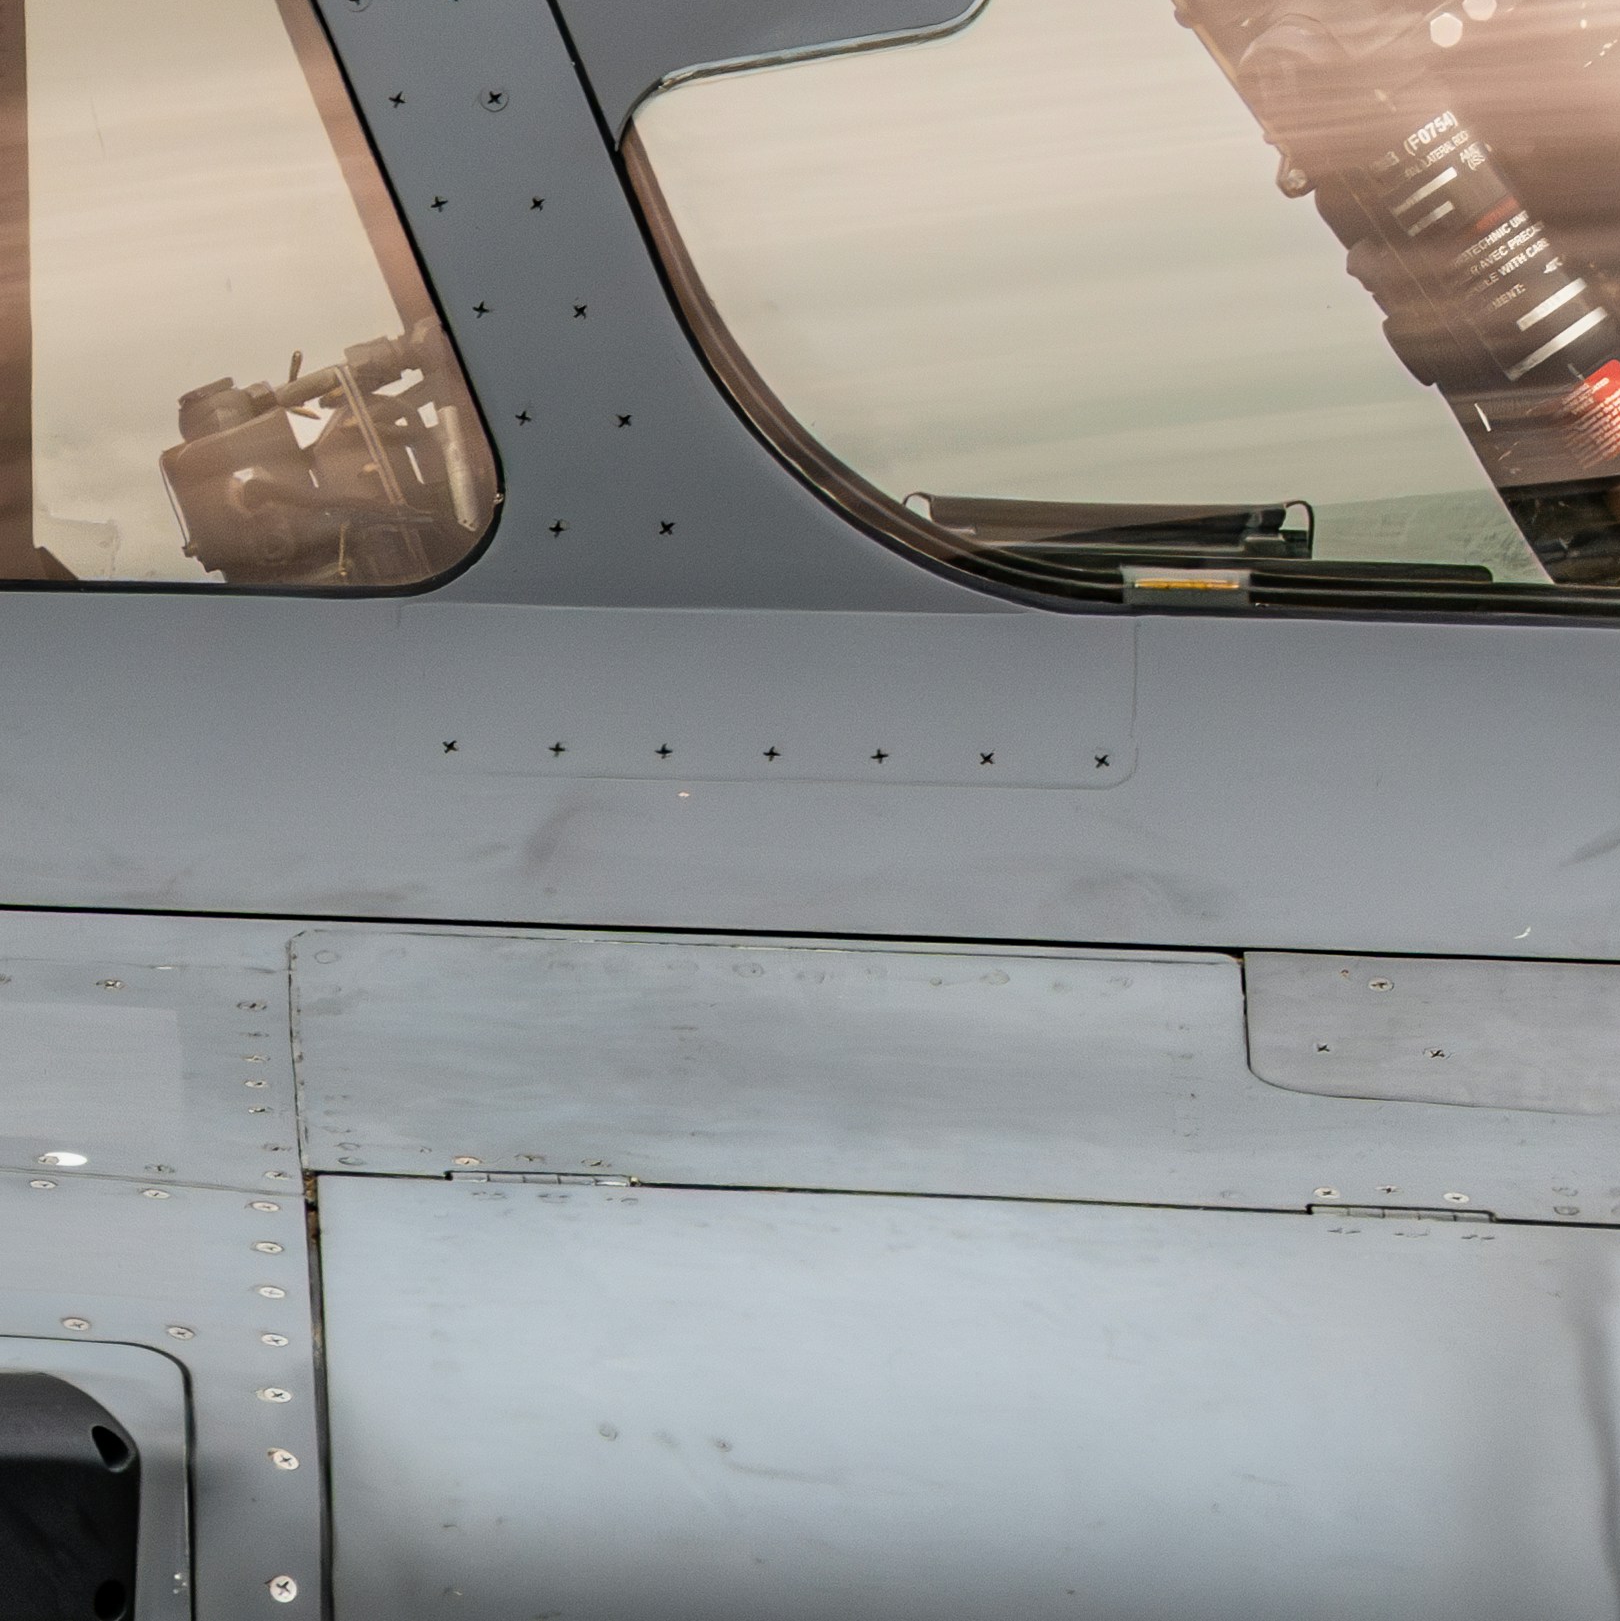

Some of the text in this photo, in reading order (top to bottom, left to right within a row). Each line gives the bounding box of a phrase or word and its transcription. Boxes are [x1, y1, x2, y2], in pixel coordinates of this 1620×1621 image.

[1403, 110, 1459, 157] (F0754)
[1480, 245, 1509, 269] AVEC
[1498, 253, 1528, 276] WITH
